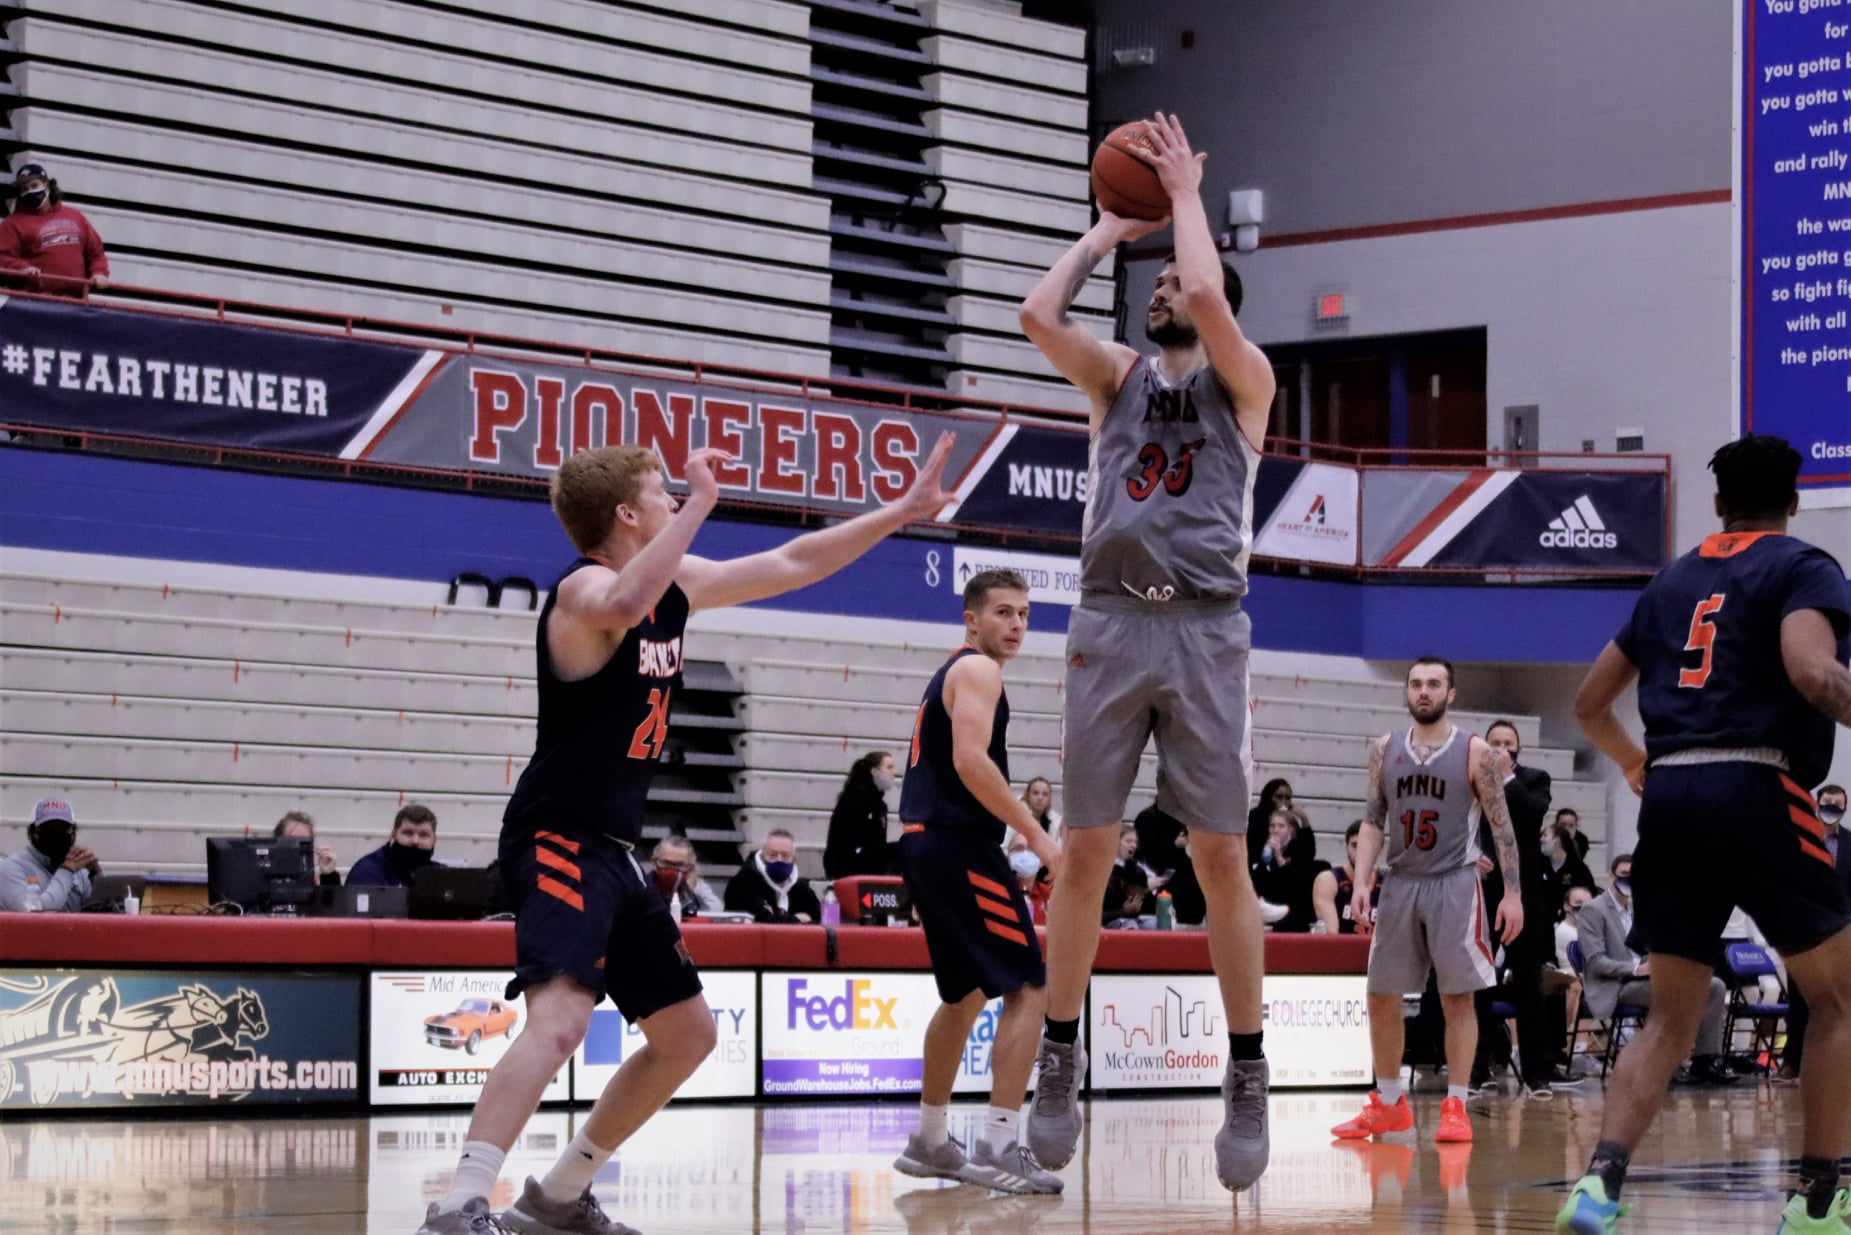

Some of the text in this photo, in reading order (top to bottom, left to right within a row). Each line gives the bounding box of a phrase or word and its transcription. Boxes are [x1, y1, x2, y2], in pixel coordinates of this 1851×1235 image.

[1765, 0, 1794, 14] You
[1825, 22, 1848, 39] for
[1764, 63, 1793, 82] you
[1798, 57, 1840, 78] gotta
[1761, 95, 1790, 115] you
[1795, 89, 1838, 110] gotta
[1809, 119, 1838, 137] win
[1774, 150, 1848, 173] and rally
[1797, 217, 1823, 234] the
[1762, 256, 1790, 274] you
[1796, 250, 1838, 271] gotta
[1772, 279, 1851, 302] so fight fi
[1786, 311, 1846, 332] with all
[1781, 345, 1851, 366] the pion
[3, 345, 329, 417] #FEARTHENEER
[469, 367, 920, 504] PIONEERS
[1126, 438, 1206, 502] 35
[1540, 525, 1617, 549] adidas
[925, 550, 940, 587] 8
[1678, 594, 1725, 688] 5
[627, 687, 671, 759] 24
[1396, 775, 1446, 800] MNU
[1401, 810, 1439, 851] 15
[873, 894, 899, 907] POSS.
[429, 976, 454, 992] Mid
[788, 979, 898, 1031] FedEx
[398, 1072, 438, 1085] AUTO
[819, 1062, 870, 1077] Now Hiring
[764, 1078, 922, 1092] GroundWarehouseJobs.FedEx.com
